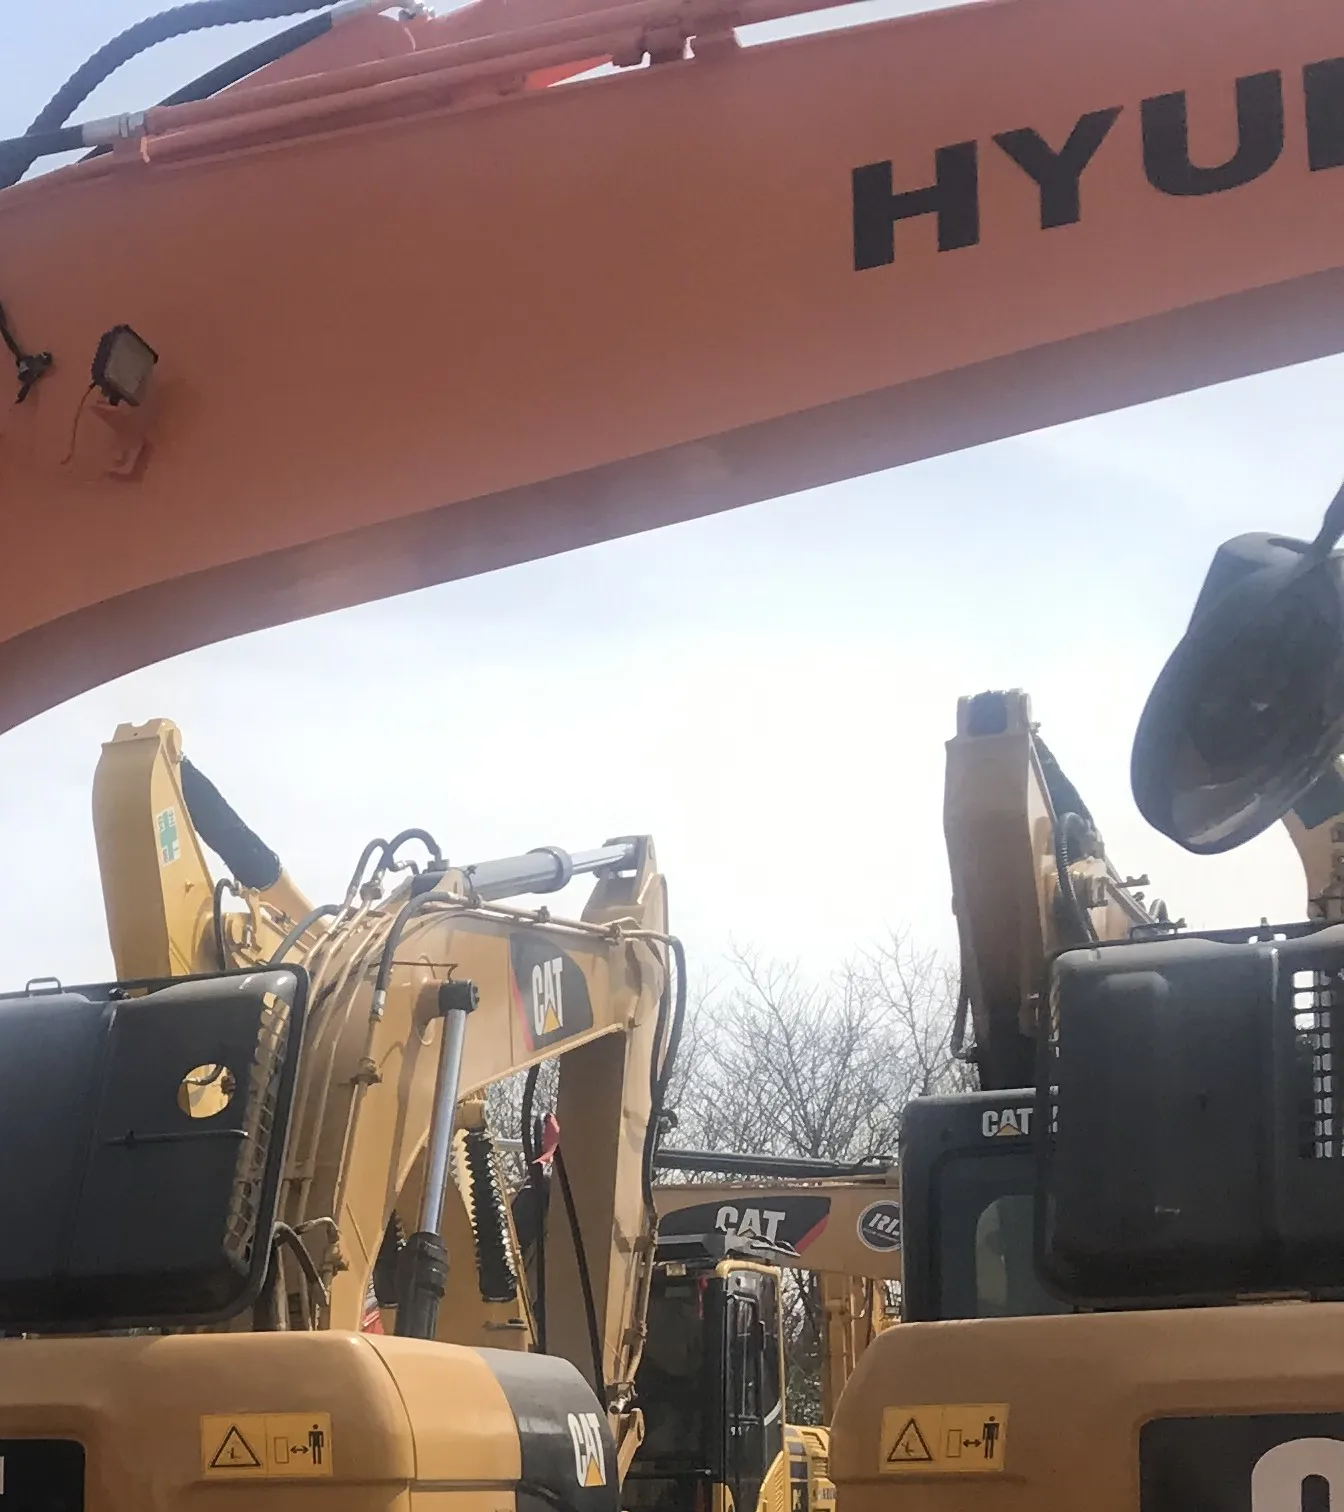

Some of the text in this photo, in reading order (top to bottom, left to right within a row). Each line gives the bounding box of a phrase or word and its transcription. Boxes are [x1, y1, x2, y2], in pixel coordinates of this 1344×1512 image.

[532, 956, 564, 1036] CAT
[982, 1107, 1034, 1137] CAT
[715, 1205, 786, 1245] CAT
[567, 1412, 607, 1488] CAT
